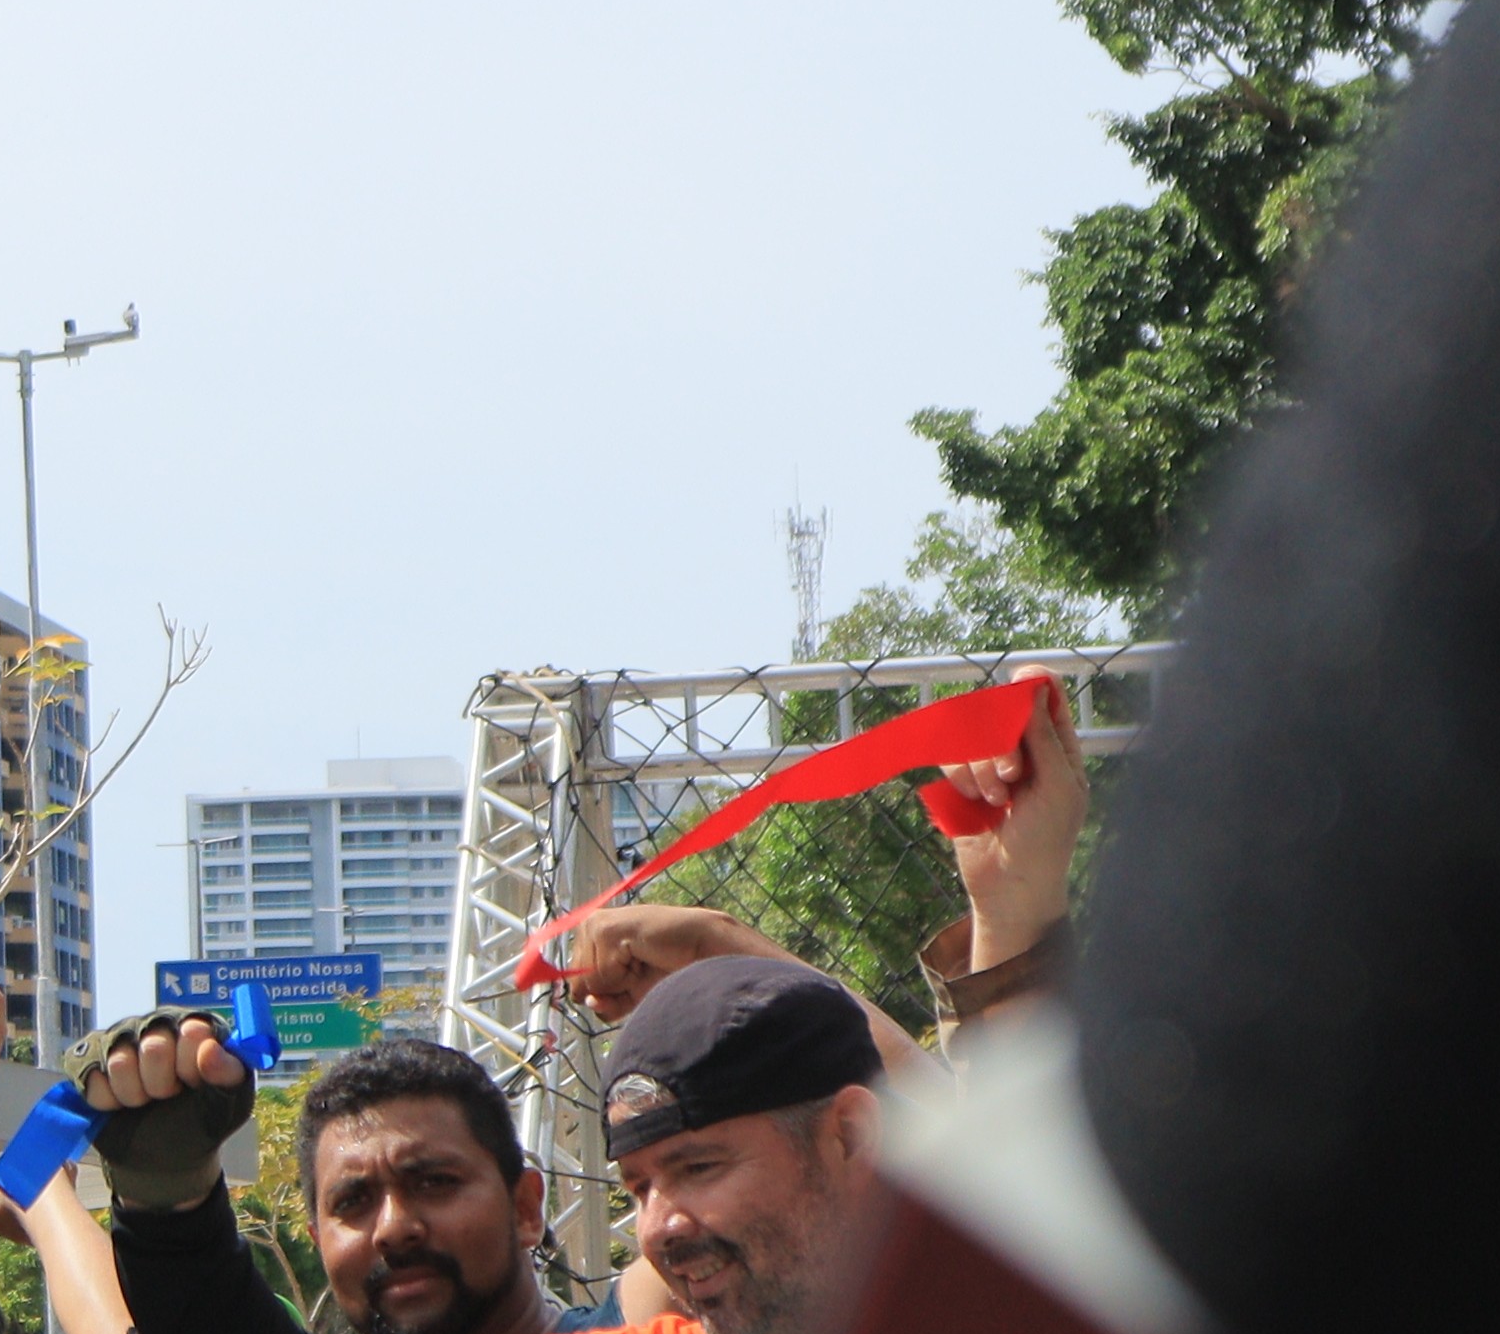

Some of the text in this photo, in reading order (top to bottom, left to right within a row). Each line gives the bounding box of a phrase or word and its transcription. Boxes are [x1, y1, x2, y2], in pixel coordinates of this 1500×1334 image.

[217, 961, 364, 980] Cemitério Nossa
[276, 1011, 326, 1026] rismo
[278, 1031, 313, 1044] turo
